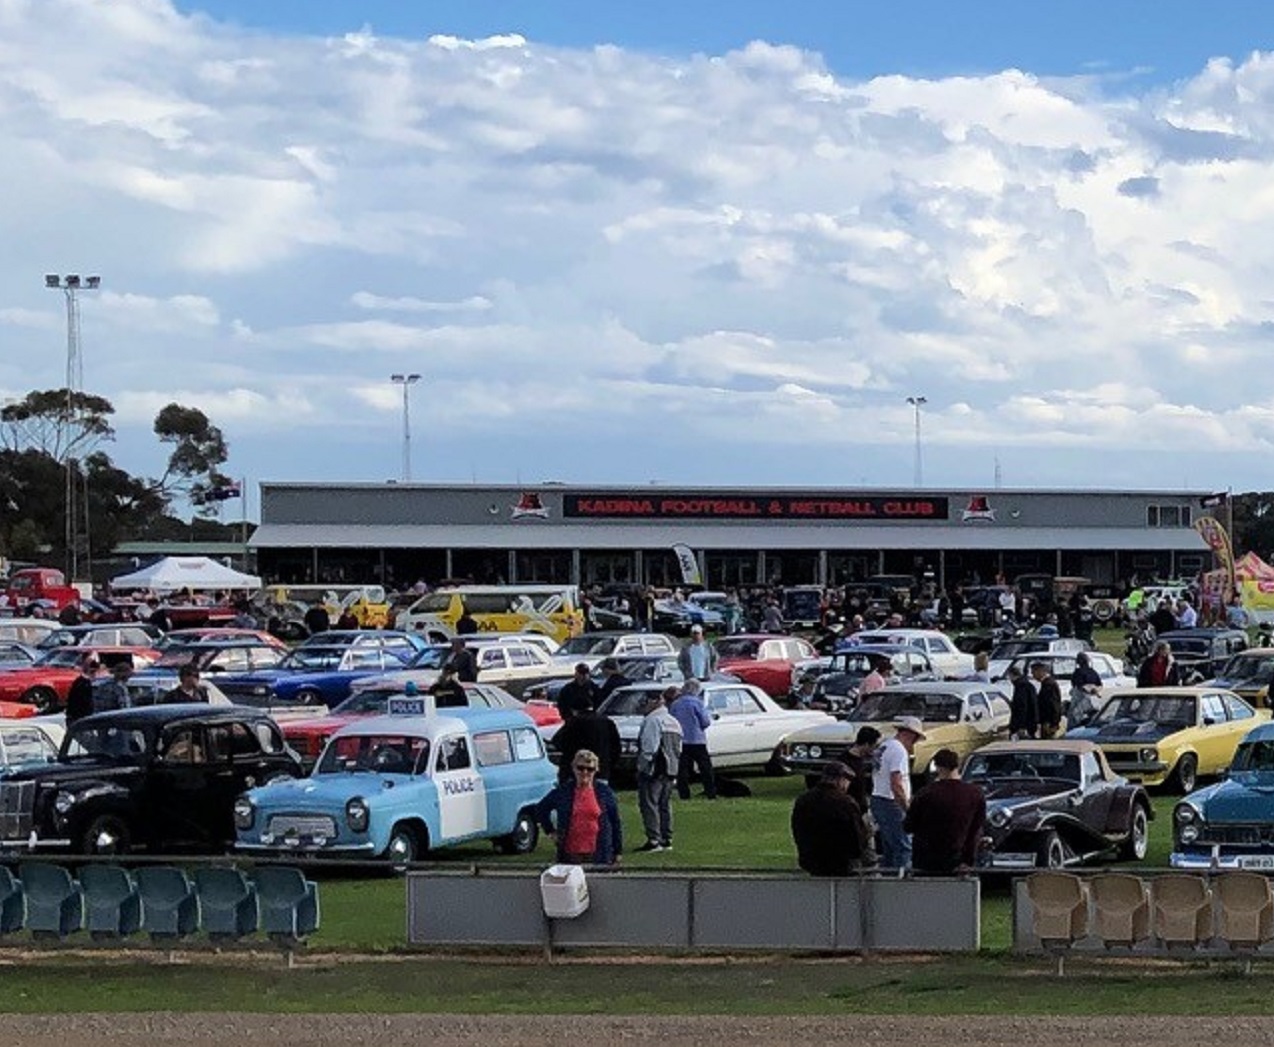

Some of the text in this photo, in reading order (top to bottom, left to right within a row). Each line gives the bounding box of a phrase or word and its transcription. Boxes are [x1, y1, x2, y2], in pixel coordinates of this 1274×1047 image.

[578, 500, 933, 514] KADINA FOOTBALL & NETBALL CLUB
[391, 700, 423, 713] POLICE
[442, 777, 475, 795] POLICE
